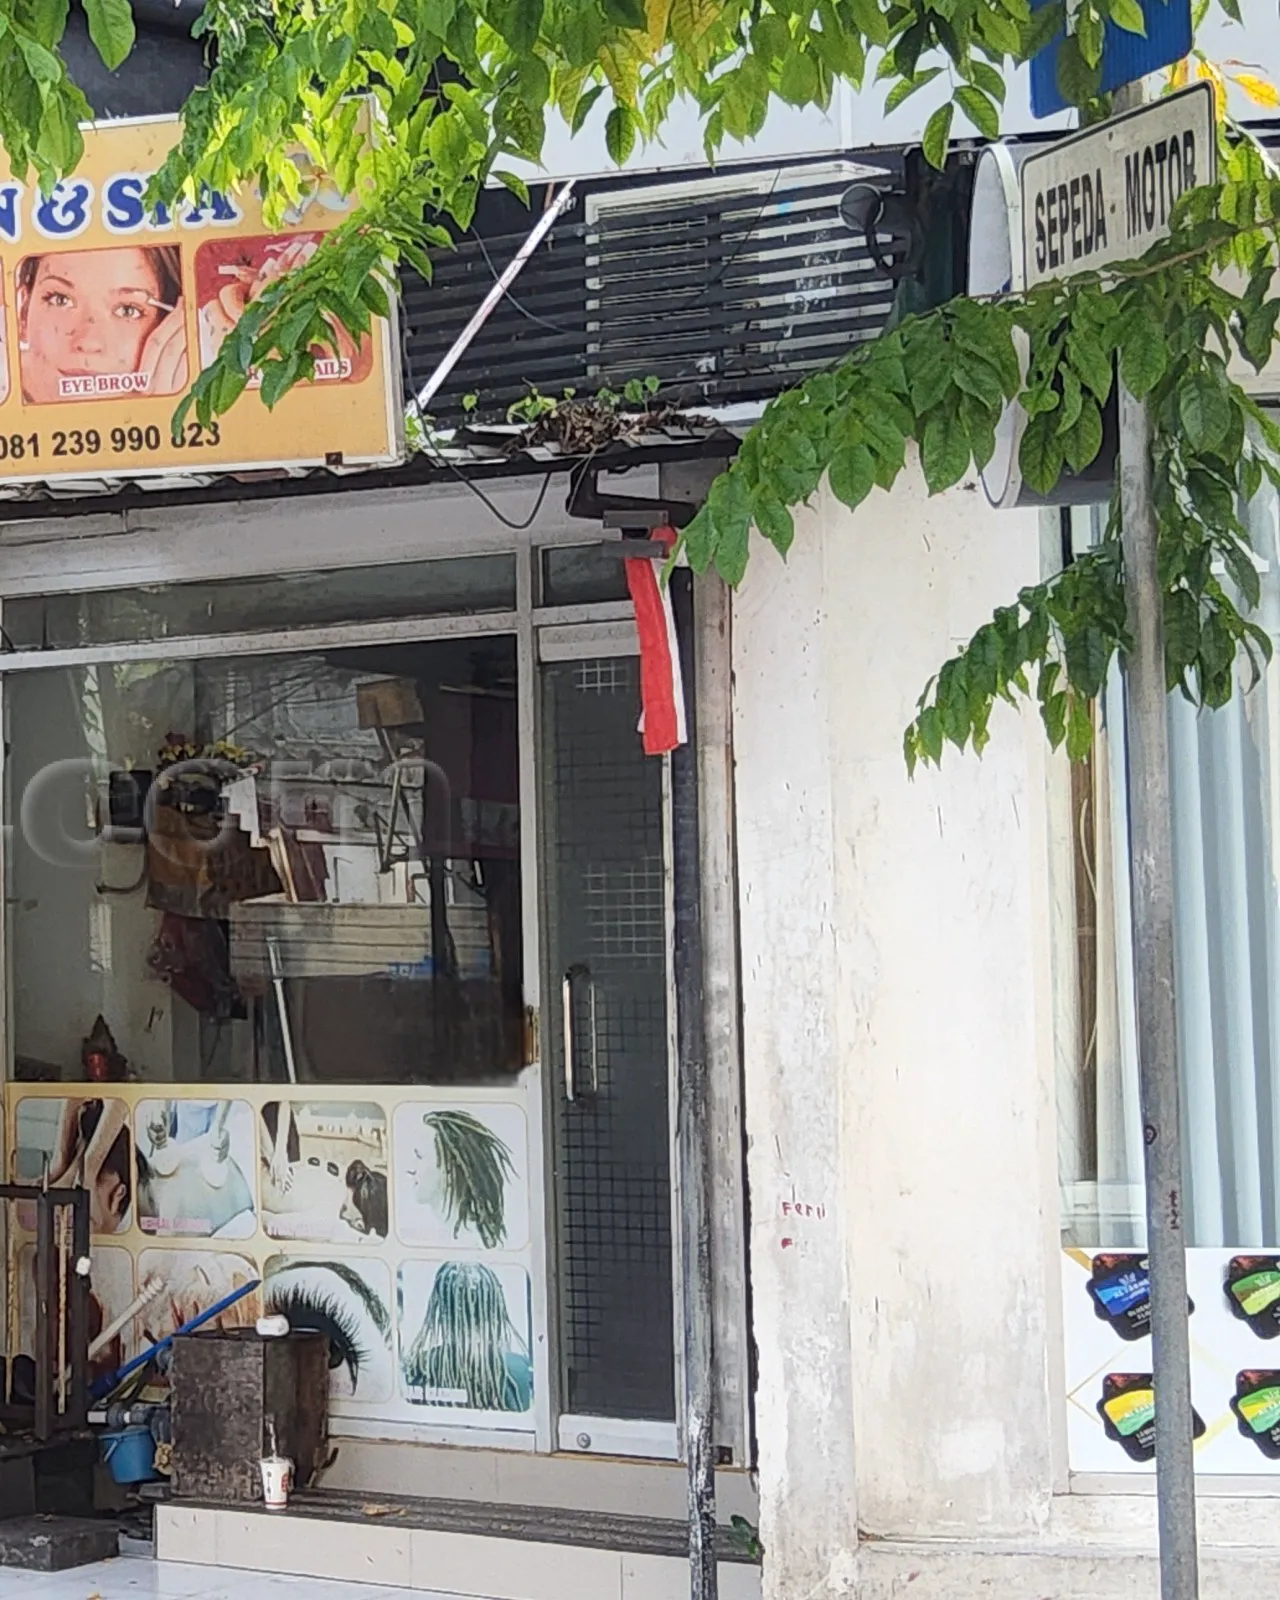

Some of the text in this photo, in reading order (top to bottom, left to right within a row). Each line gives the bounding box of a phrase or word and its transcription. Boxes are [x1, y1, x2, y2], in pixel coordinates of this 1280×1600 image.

[37, 182, 90, 231] &
[1035, 130, 1197, 273] SEPEDA MOTOR
[61, 373, 148, 394] EYE BROW
[314, 360, 349, 376] AILS
[52, 427, 101, 456] 239
[111, 424, 160, 452] 990
